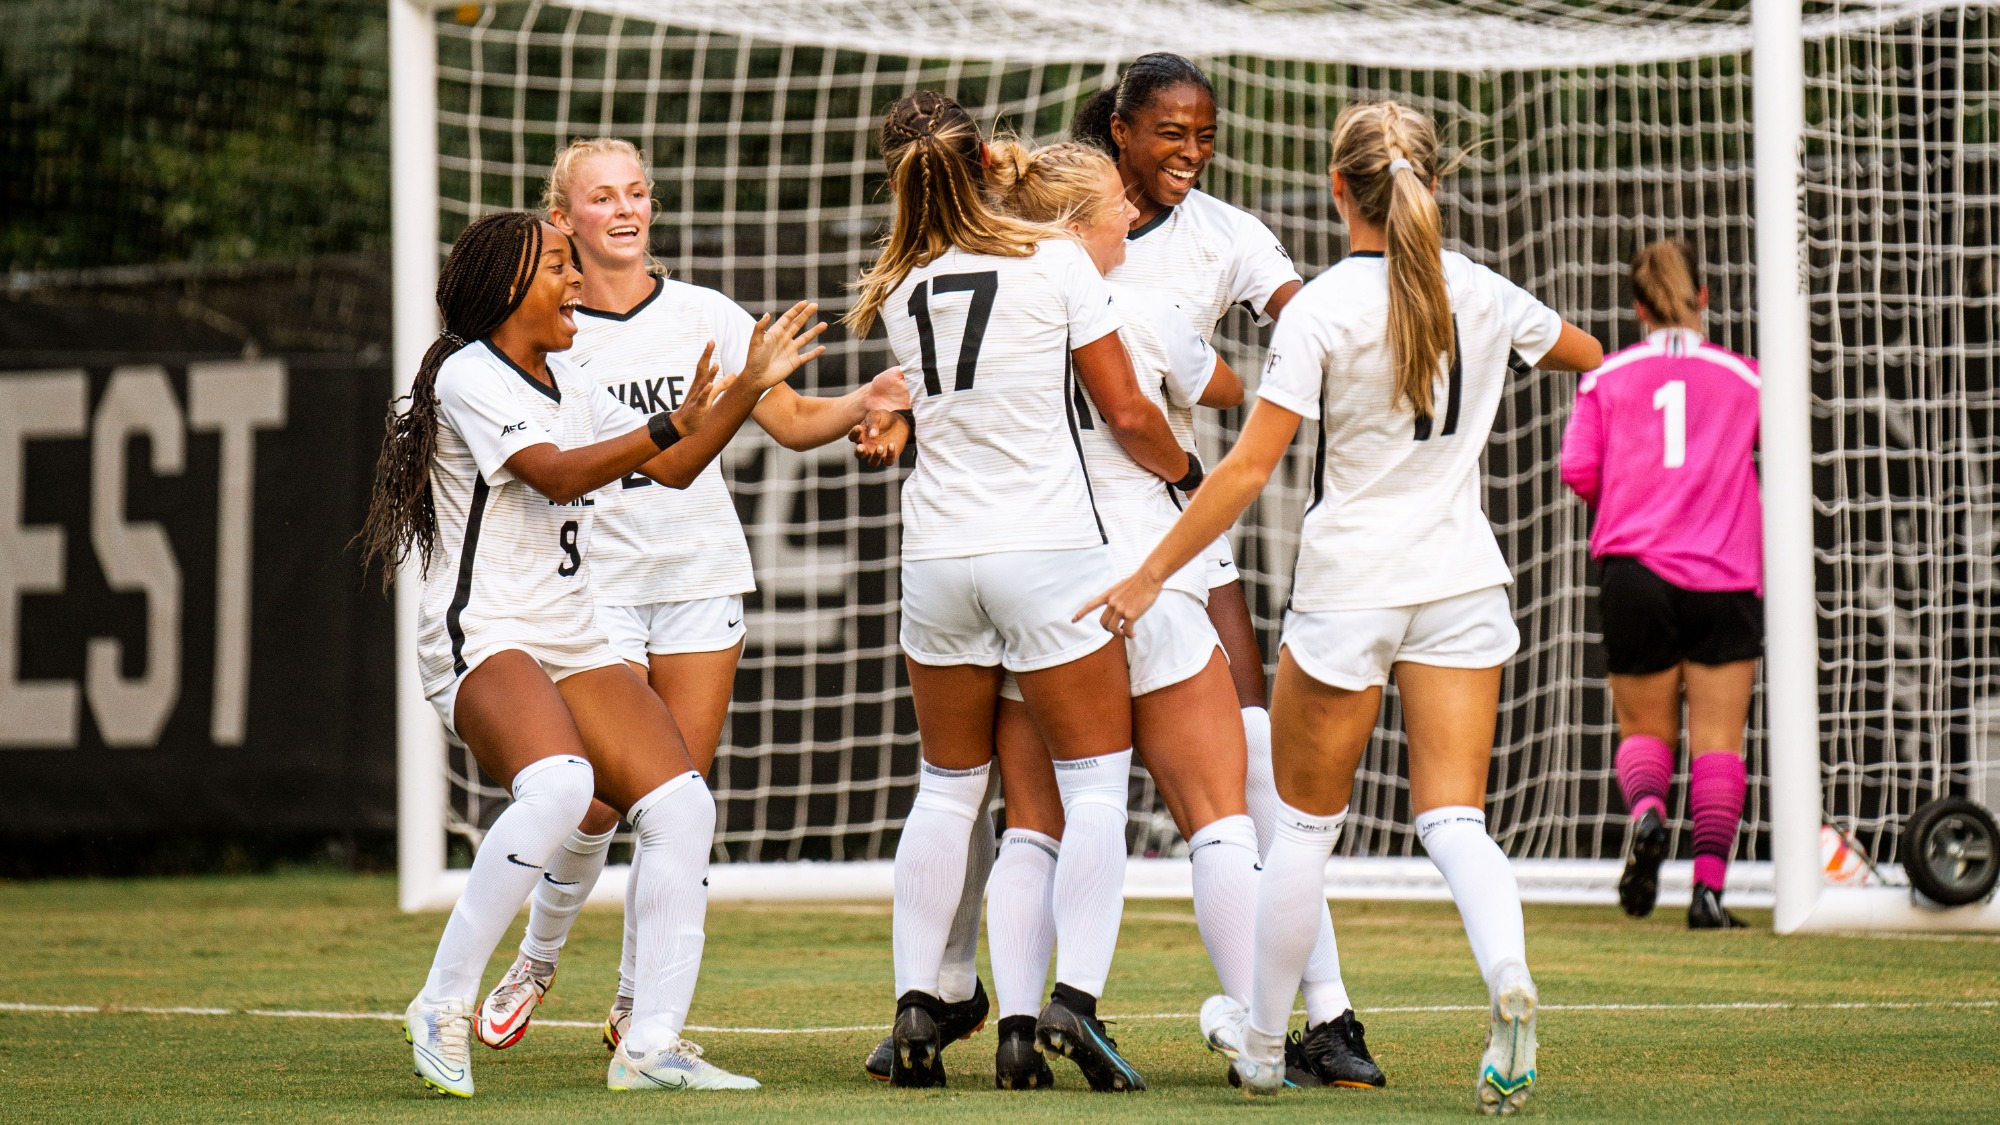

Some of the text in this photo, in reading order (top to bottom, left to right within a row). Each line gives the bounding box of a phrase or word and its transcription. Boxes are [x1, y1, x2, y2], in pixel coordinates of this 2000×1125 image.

[907, 269, 999, 397] 17
[1653, 380, 1686, 468] 1
[0, 359, 289, 749] EST
[557, 520, 581, 577] 9
